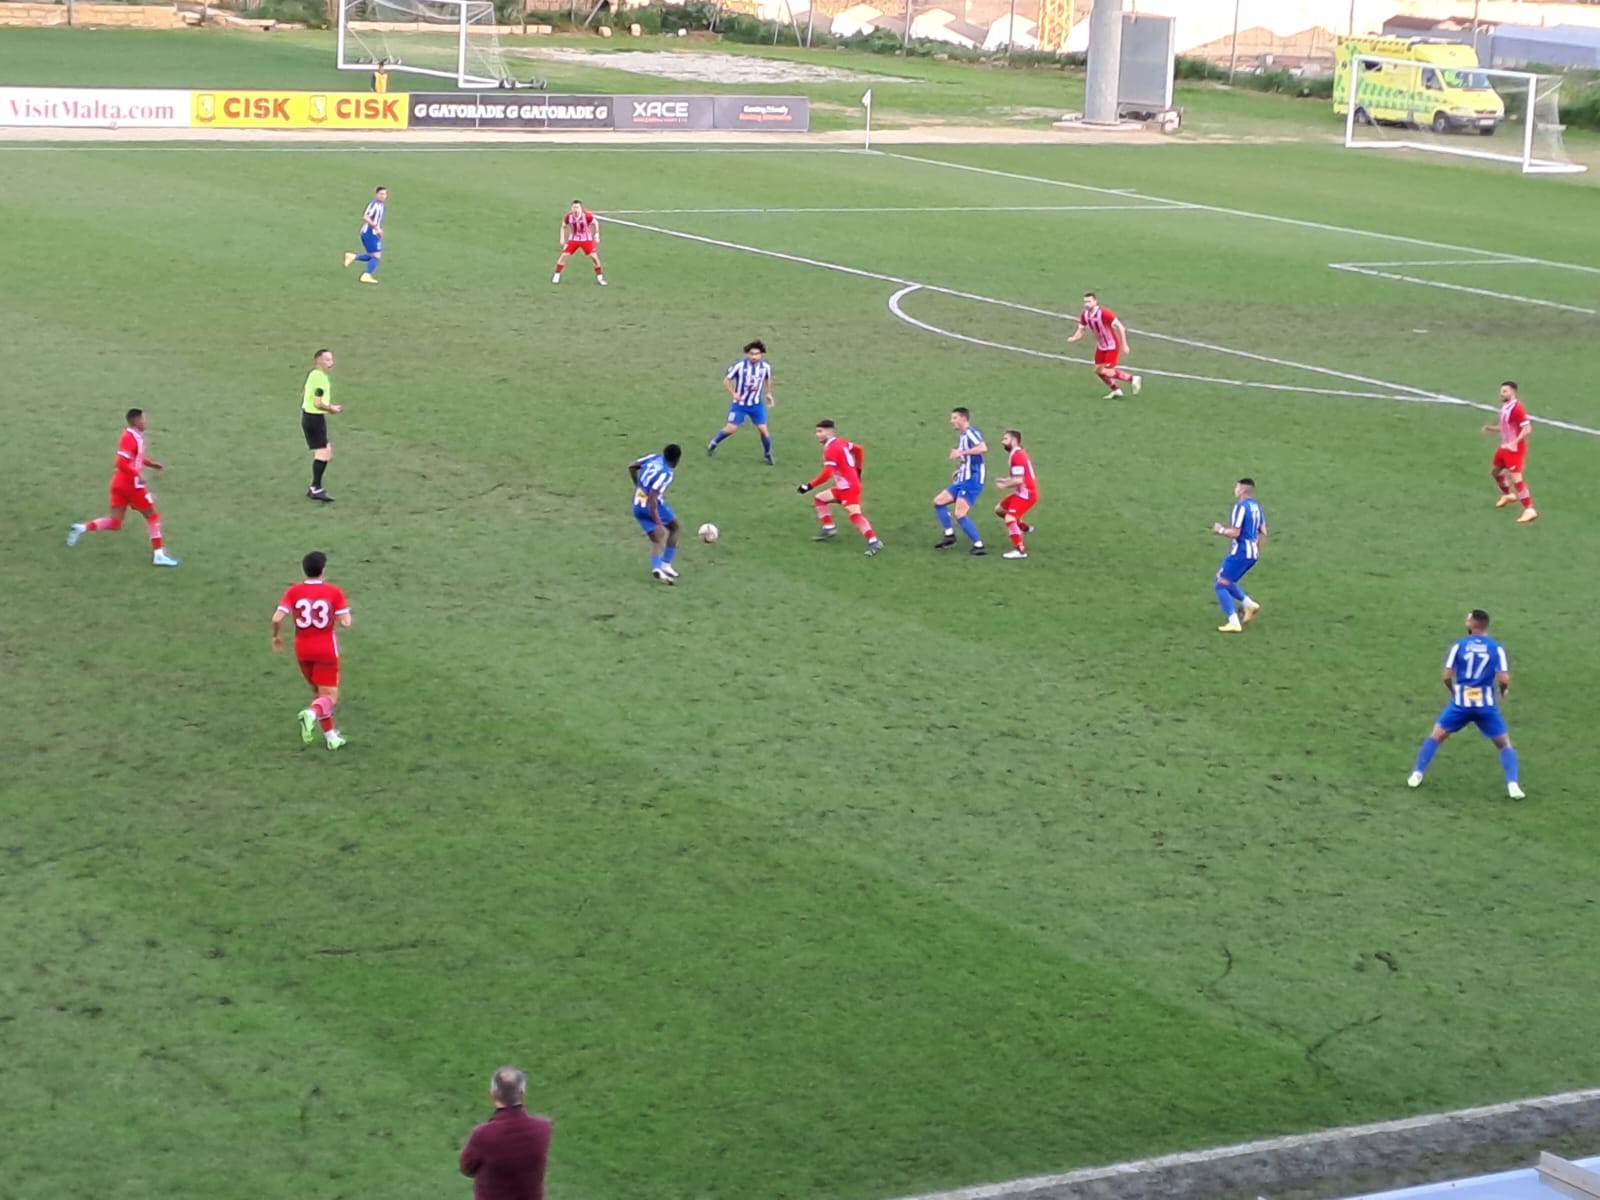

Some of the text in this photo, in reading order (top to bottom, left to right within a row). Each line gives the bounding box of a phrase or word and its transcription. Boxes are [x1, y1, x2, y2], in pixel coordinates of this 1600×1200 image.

[10, 99, 174, 120] VisitMalta.com
[223, 97, 399, 122] CISK CISK
[414, 104, 608, 119] G GATORADE G GATORADE G
[632, 101, 689, 117] XACE
[295, 598, 329, 629] 33
[1463, 652, 1490, 680] 17
